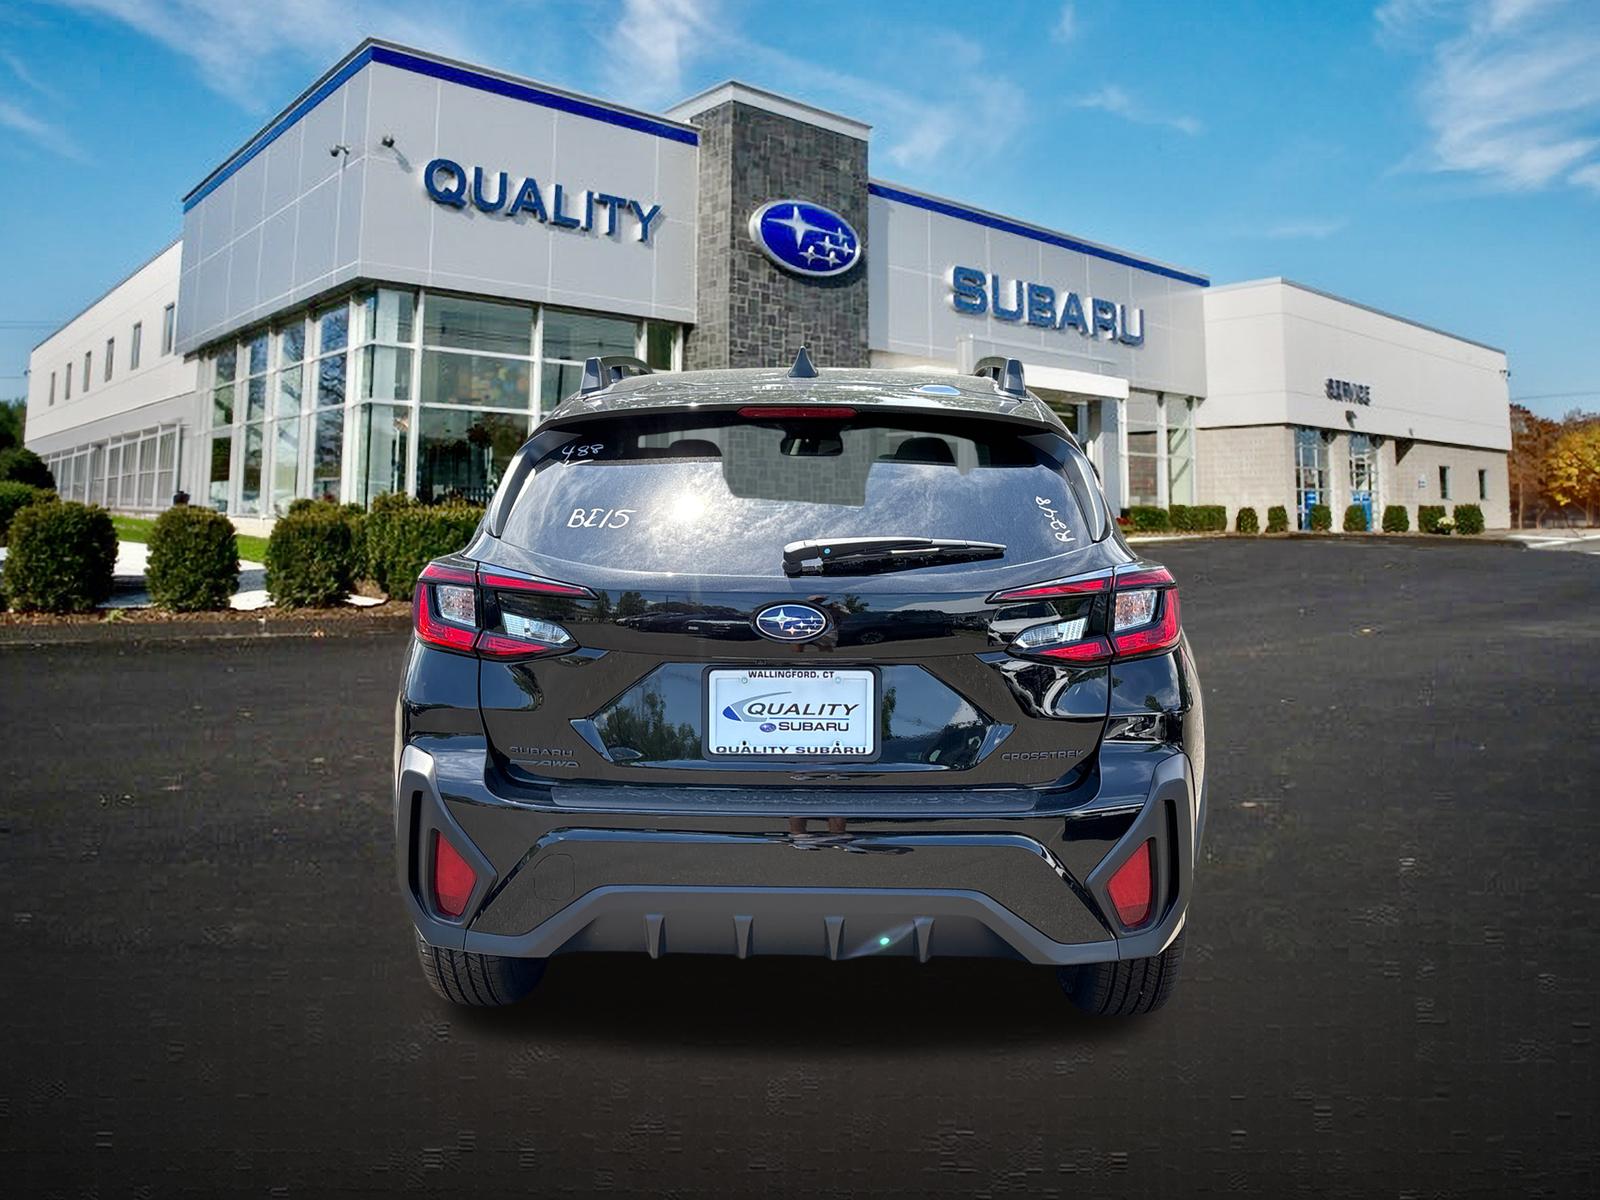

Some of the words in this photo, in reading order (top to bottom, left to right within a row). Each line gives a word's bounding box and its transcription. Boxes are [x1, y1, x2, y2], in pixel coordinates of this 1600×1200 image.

[424, 158, 662, 242] QUALITY
[951, 265, 1145, 346] SUBARU
[1325, 378, 1371, 406] SERVICE
[747, 702, 859, 716] QUALITY
[778, 722, 849, 732] SUBARU
[510, 746, 573, 757] SUBARU
[716, 746, 789, 754] QUALITY
[795, 746, 866, 754] SUBARU
[1001, 750, 1084, 761] CROSSTREK
[537, 760, 579, 768] AWD
